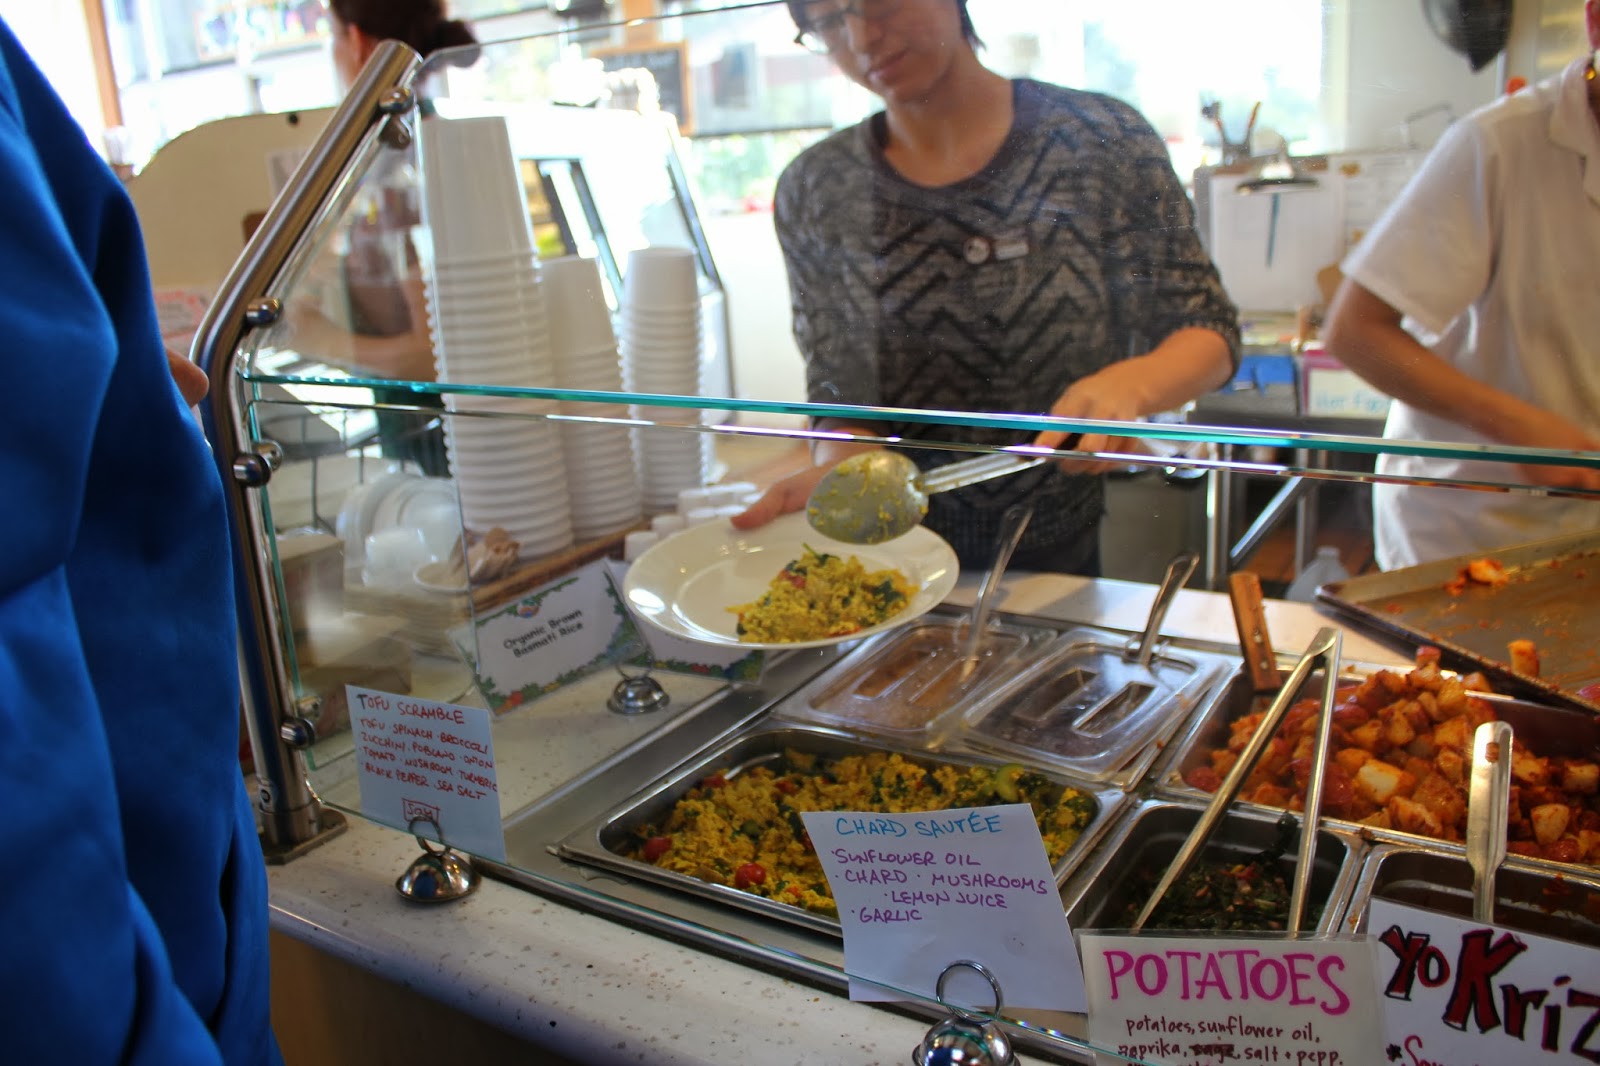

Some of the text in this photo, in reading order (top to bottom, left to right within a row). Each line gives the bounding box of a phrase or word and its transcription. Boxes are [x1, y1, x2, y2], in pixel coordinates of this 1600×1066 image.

[504, 610, 583, 649] Organic Brown
[513, 623, 583, 657] Basmati Rice
[357, 694, 465, 724] TOFU SCRAMBLE
[360, 718, 488, 754] TOFU SPINACH BROCCOLI
[361, 731, 494, 770] ZUCCHINI POBLANO ONION
[363, 746, 498, 793] TOMATO MUSHROOM TURMERIC
[365, 762, 487, 800] BLACK PEPPER SEA SALT
[836, 811, 1003, 839] CHARD SAUTÉE
[835, 848, 982, 867] SUNFLOWER OIL
[845, 869, 1048, 895] CHARD MUSHROOMS
[892, 890, 1008, 909] LEMON JUICE
[859, 907, 923, 924] GARLIC
[1103, 949, 1351, 1017] POTATOES
[1126, 1014, 1321, 1044] potatoes, sunflower oil,
[1244, 1042, 1278, 1061] salt
